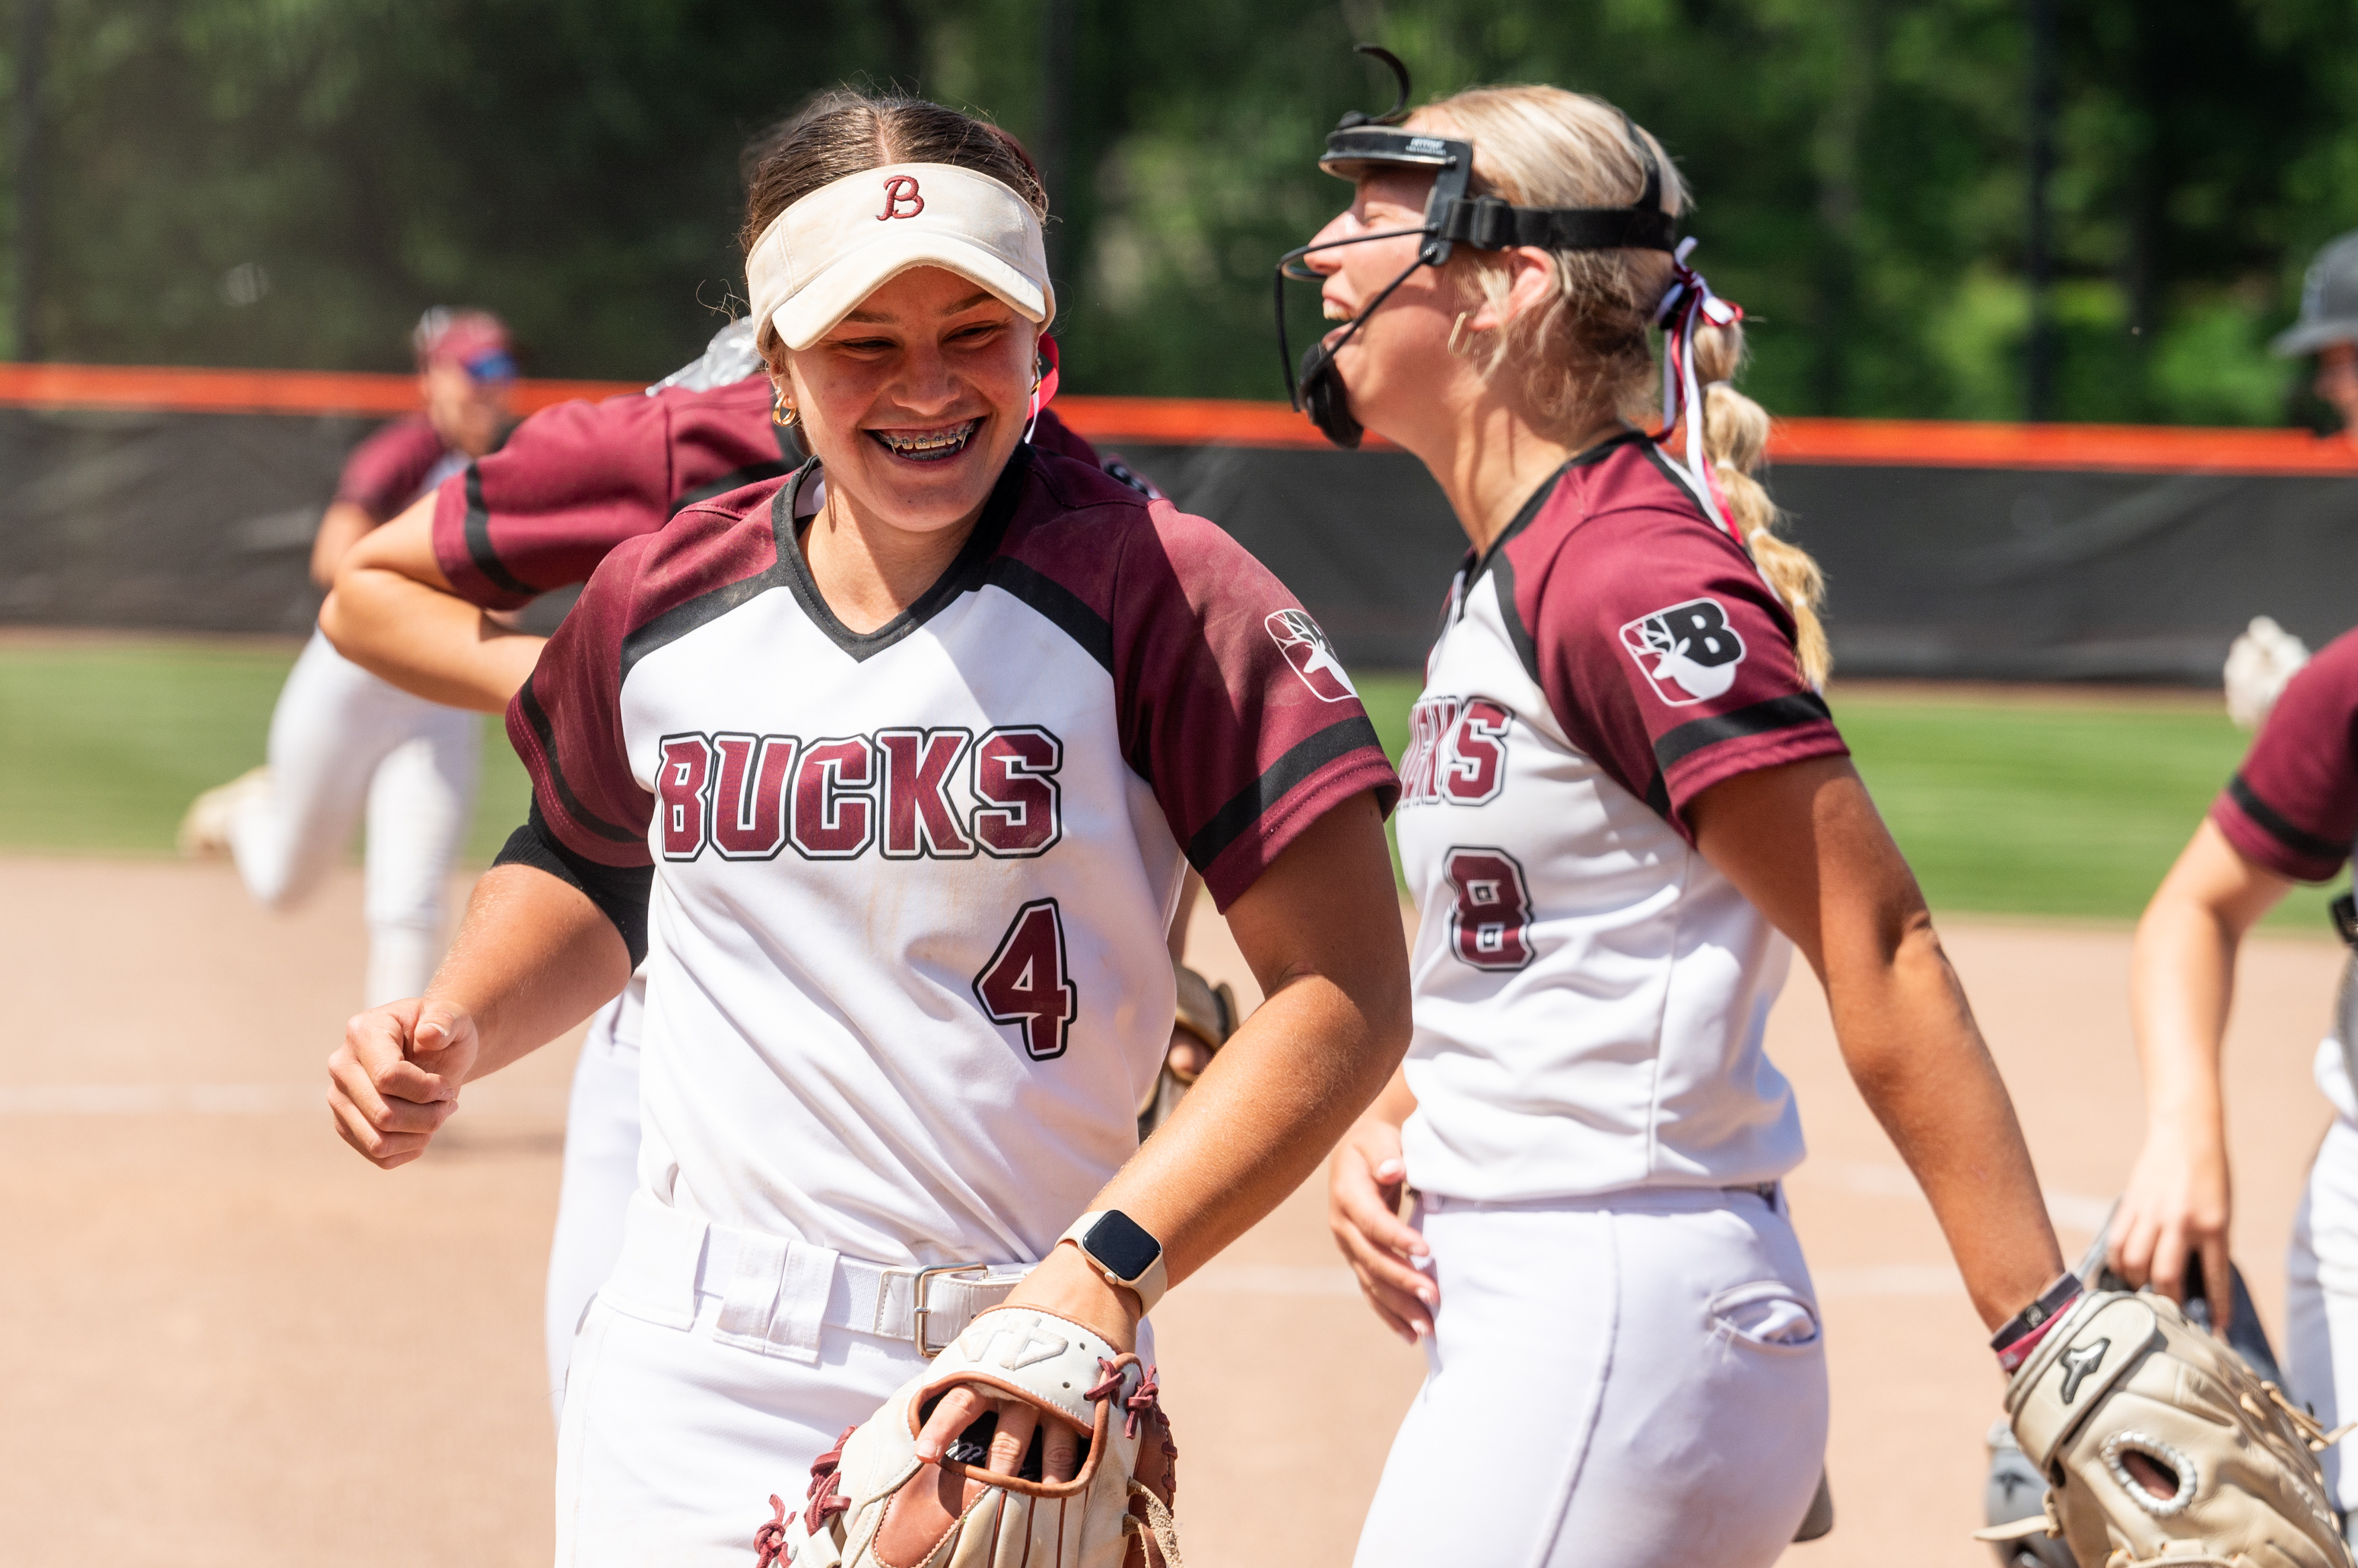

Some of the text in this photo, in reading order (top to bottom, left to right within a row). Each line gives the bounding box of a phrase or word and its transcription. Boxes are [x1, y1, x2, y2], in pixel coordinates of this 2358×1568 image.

[876, 175, 925, 221] B
[656, 724, 1064, 862] BUCKS
[1442, 846, 1537, 973] 8
[971, 897, 1078, 1062] 4
